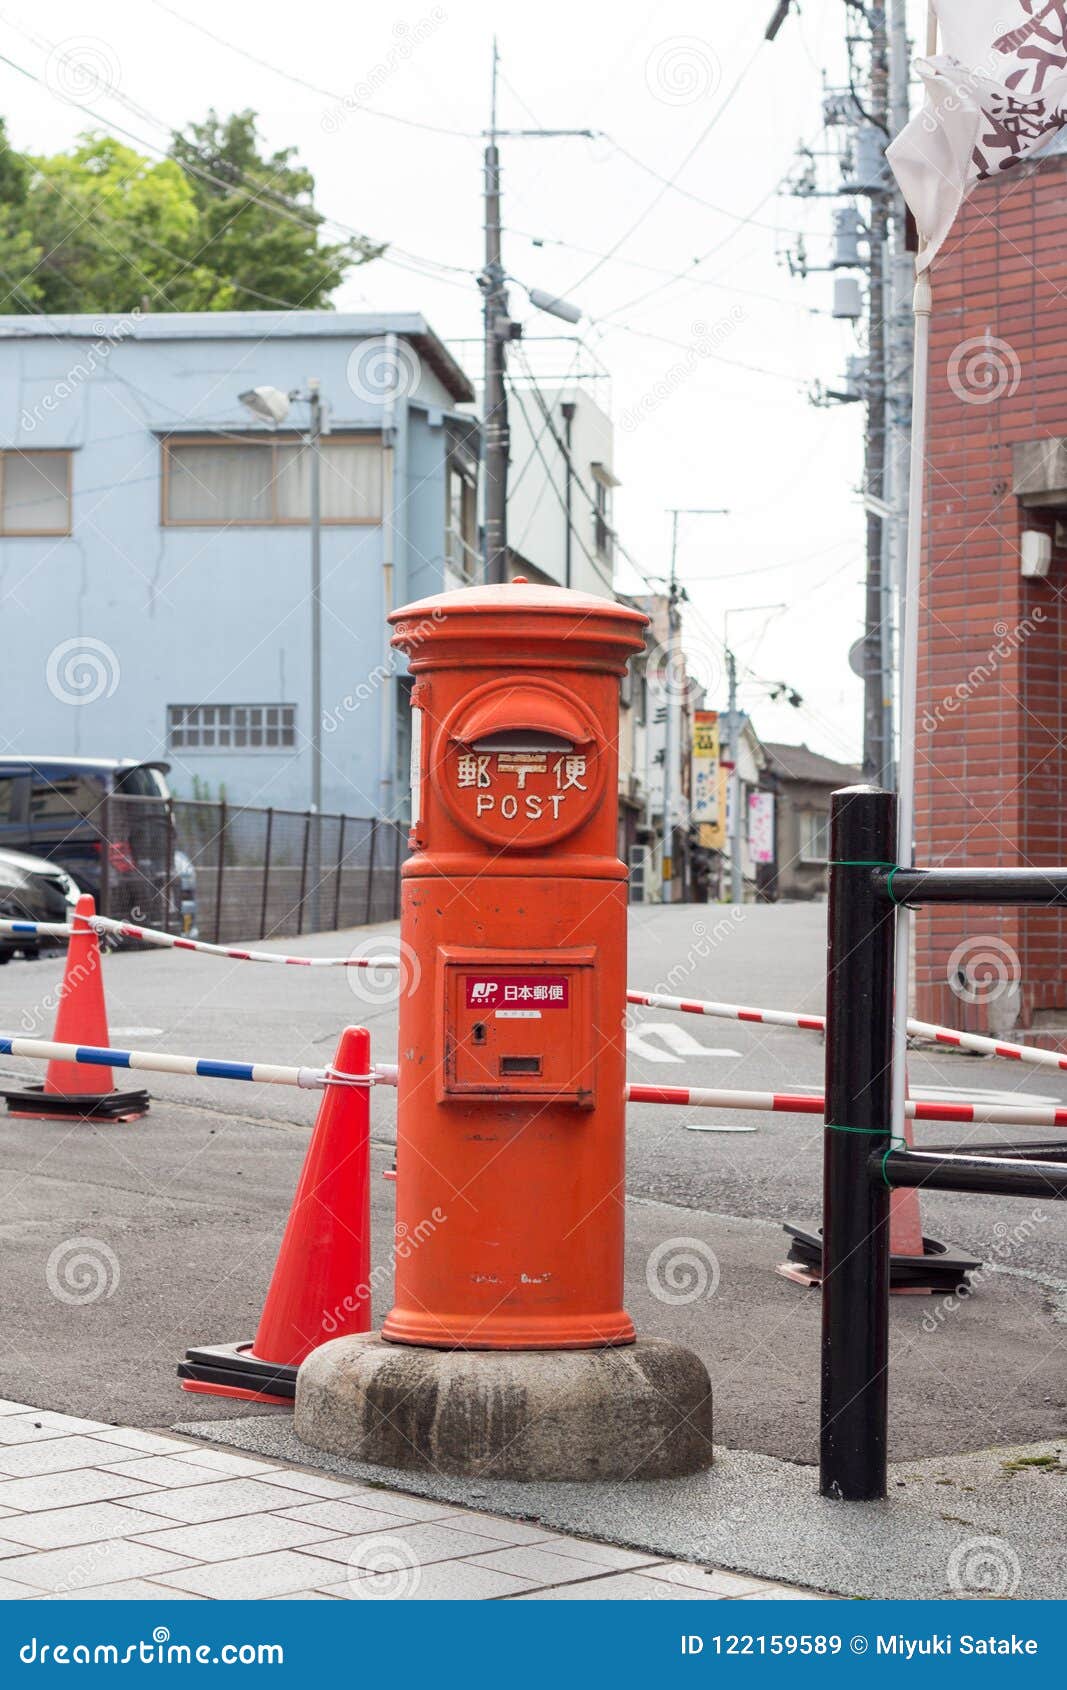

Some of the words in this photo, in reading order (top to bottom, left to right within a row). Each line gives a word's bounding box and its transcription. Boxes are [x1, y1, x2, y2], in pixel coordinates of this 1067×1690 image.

[476, 794, 566, 819] POST
[504, 985, 564, 1001] 日本郵便
